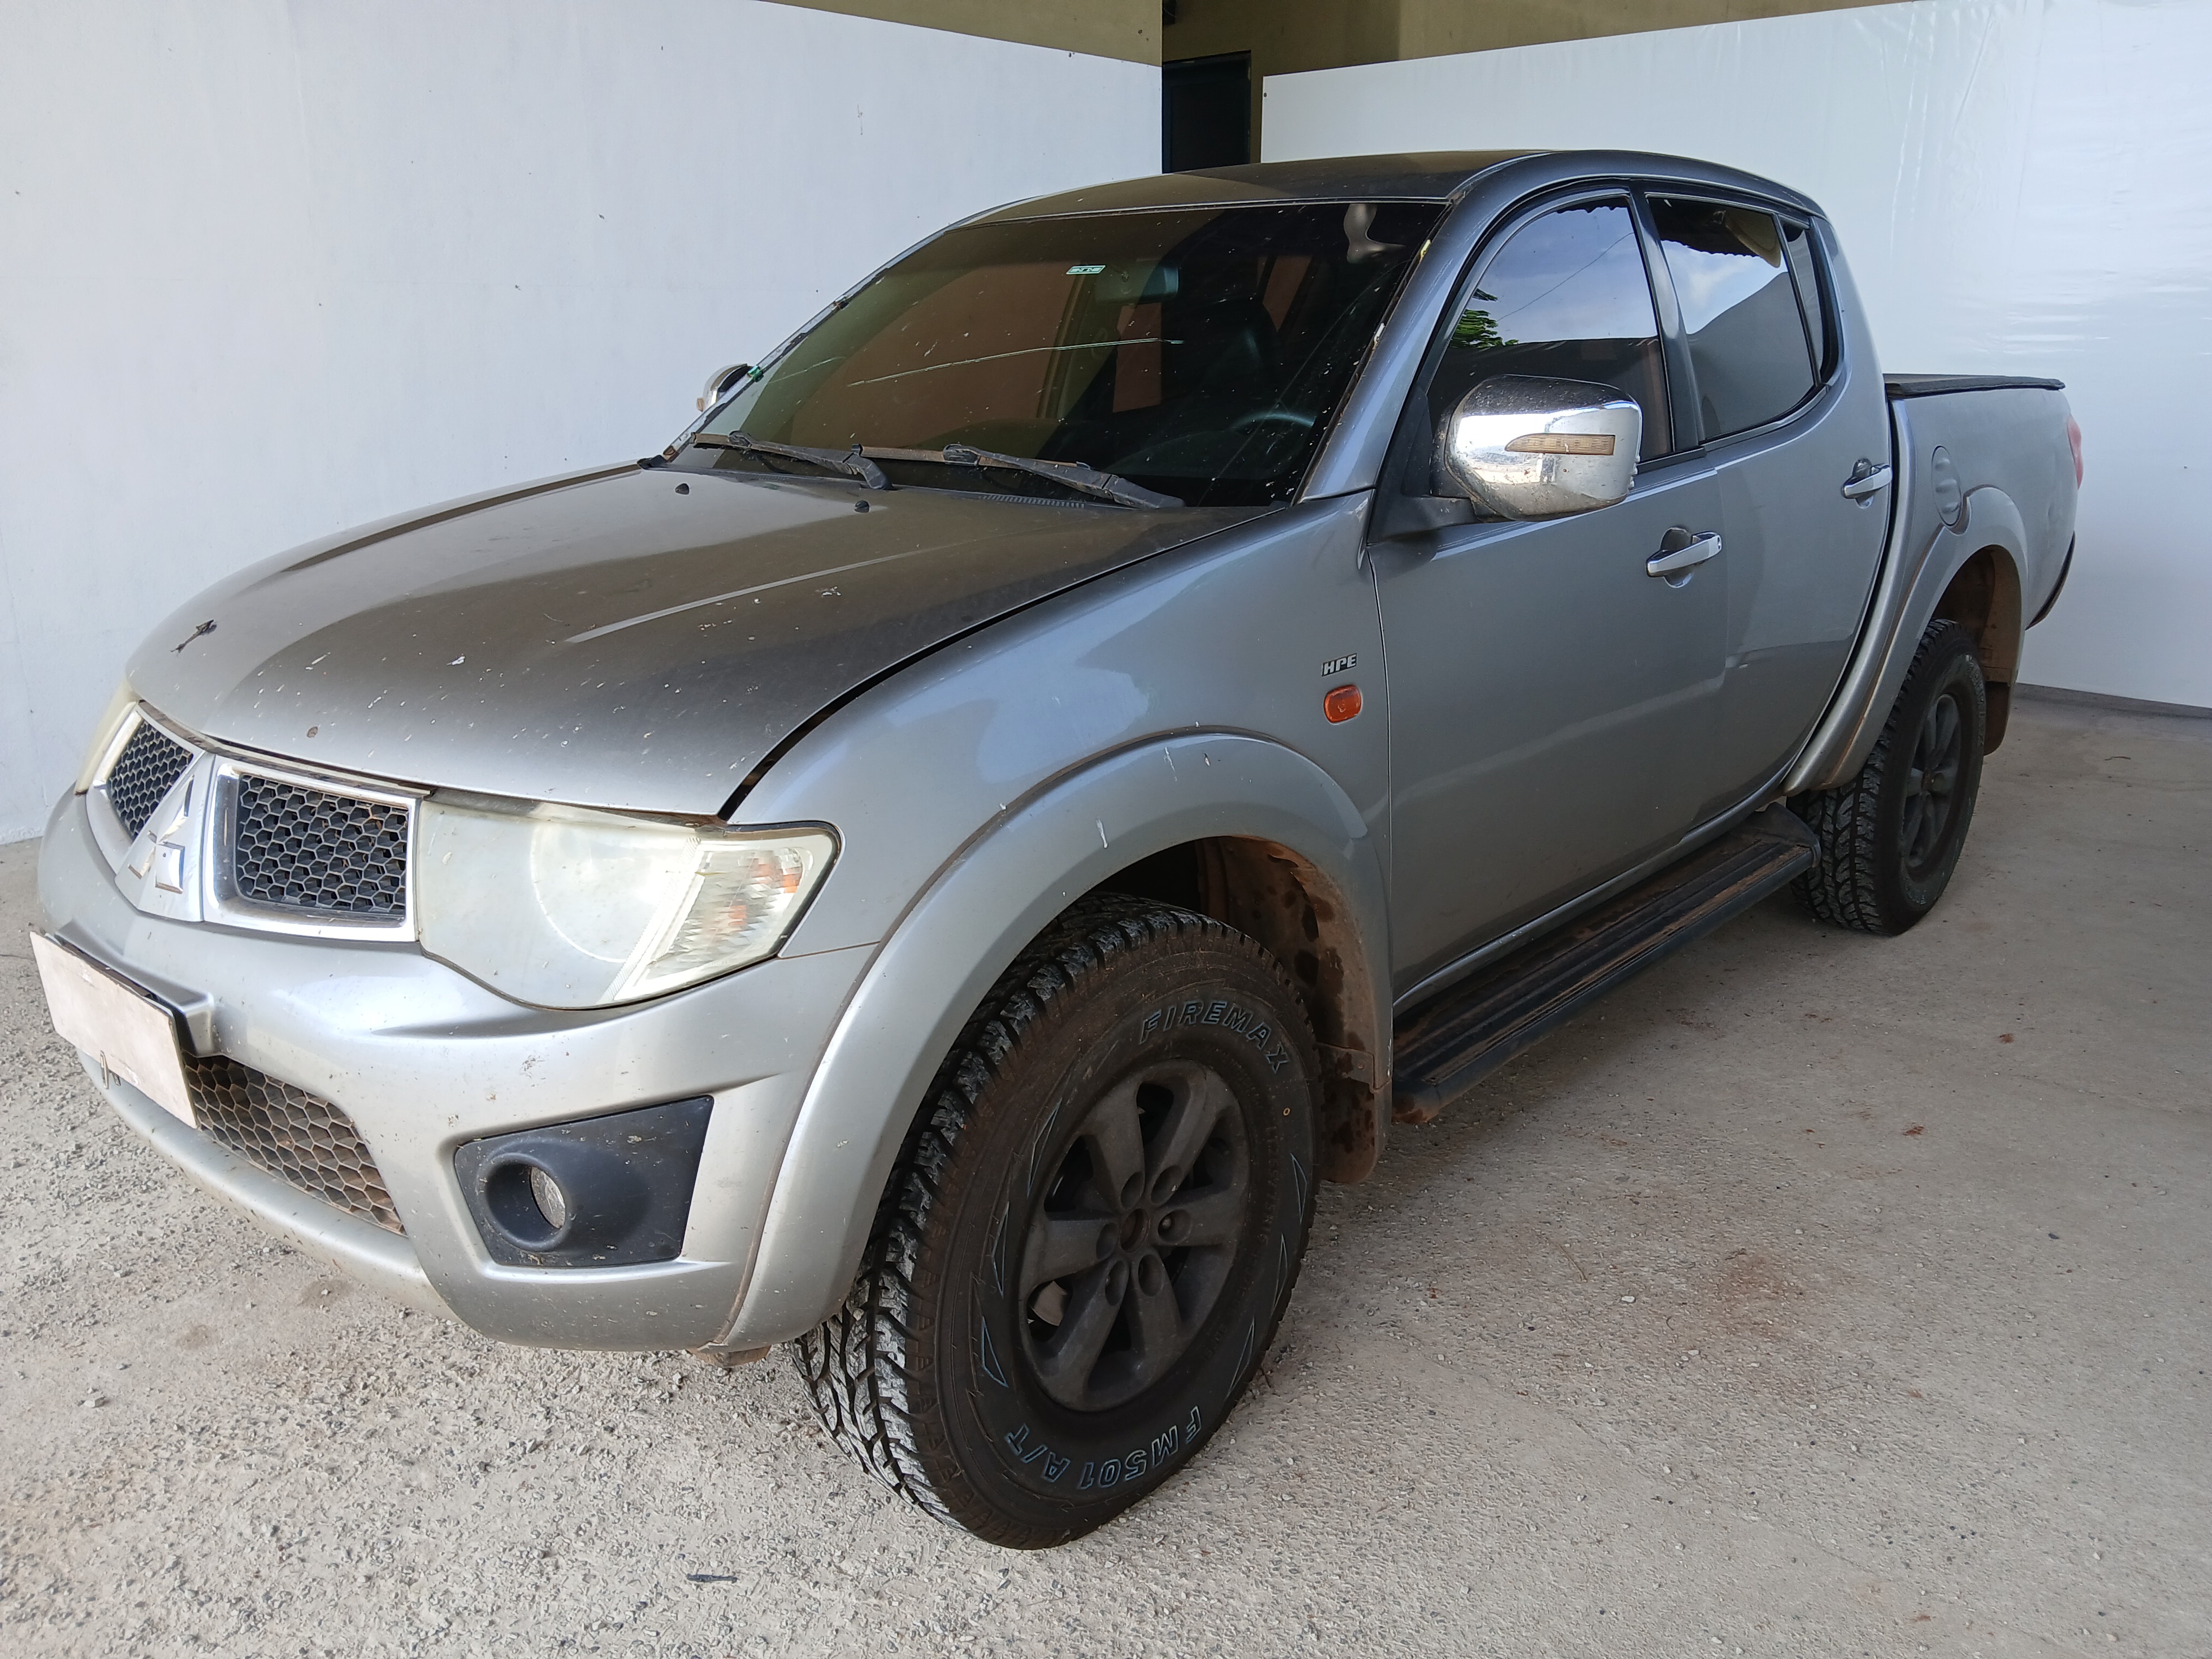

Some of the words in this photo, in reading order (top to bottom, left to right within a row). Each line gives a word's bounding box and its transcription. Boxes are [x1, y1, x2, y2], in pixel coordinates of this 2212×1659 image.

[1323, 654, 1357, 676] HPE
[1139, 999, 1290, 1073] FIREMAX
[1004, 1423, 1071, 1483] A/T
[1077, 1405, 1203, 1490] FM501
